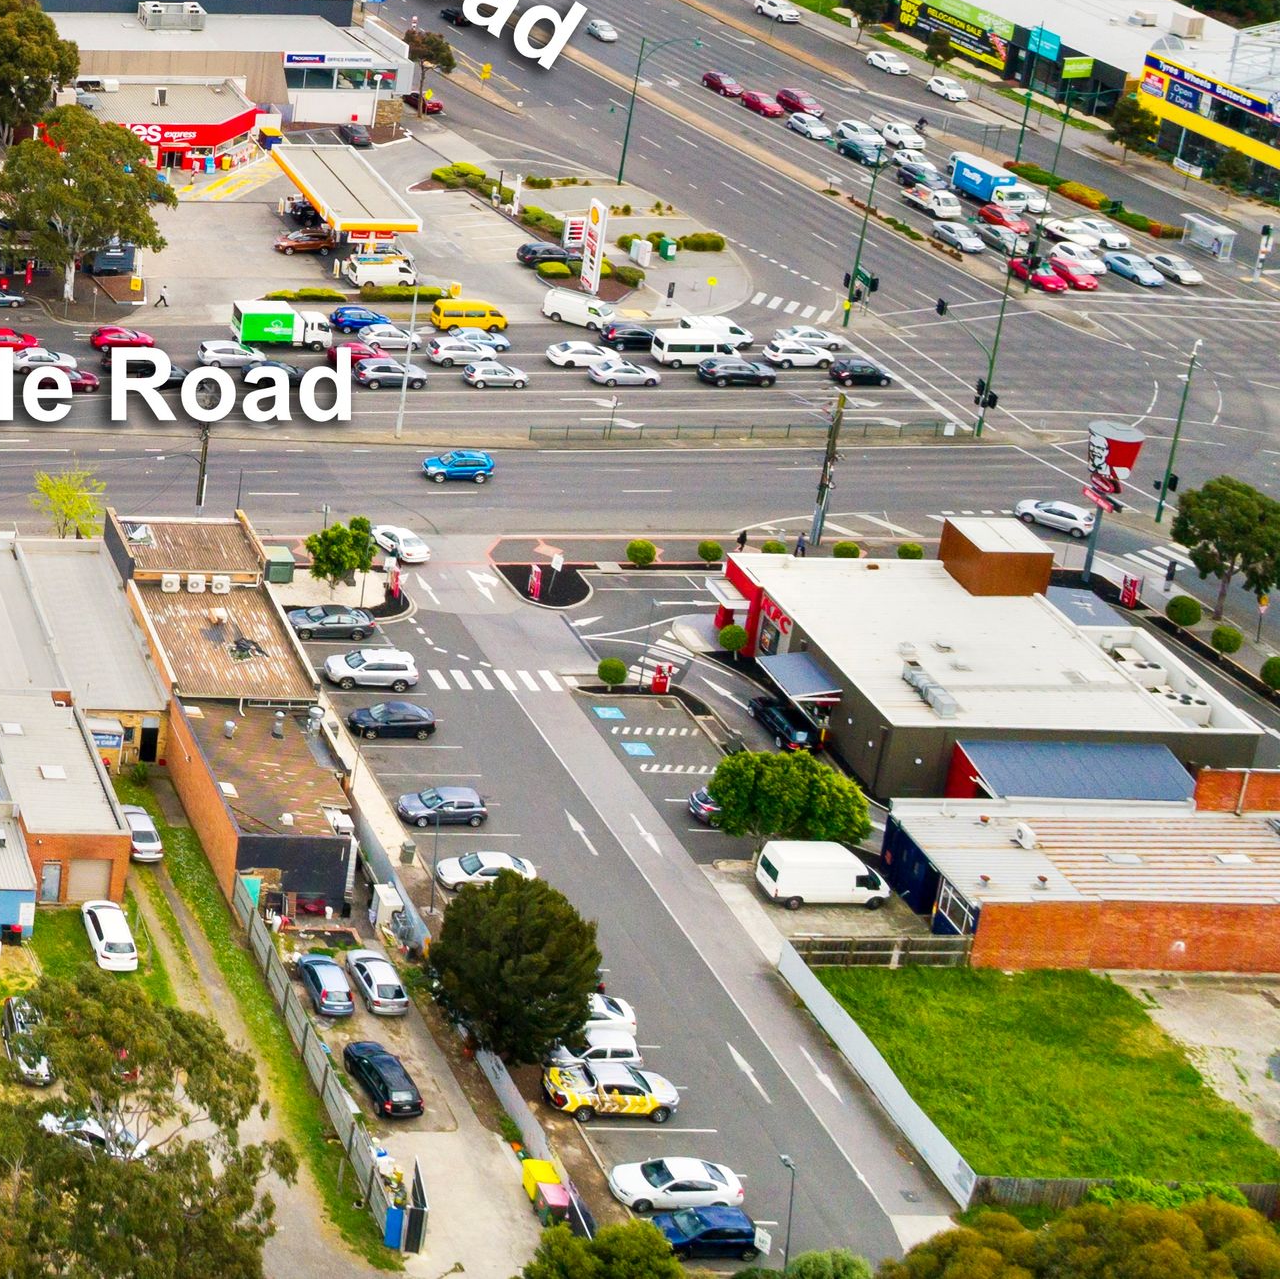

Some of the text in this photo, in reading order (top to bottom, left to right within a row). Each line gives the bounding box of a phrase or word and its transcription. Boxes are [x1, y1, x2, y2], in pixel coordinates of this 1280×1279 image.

[900, 13, 916, 27] OFF
[927, 7, 966, 30] RELOCATION
[966, 22, 983, 37] SALE
[1159, 60, 1179, 76] Tyres
[1184, 70, 1212, 89] Wheels
[1216, 85, 1252, 107] Batteries
[1173, 83, 1193, 98] Open
[1175, 95, 1193, 109] Days
[164, 131, 197, 142] express
[760, 596, 792, 635] KFC
